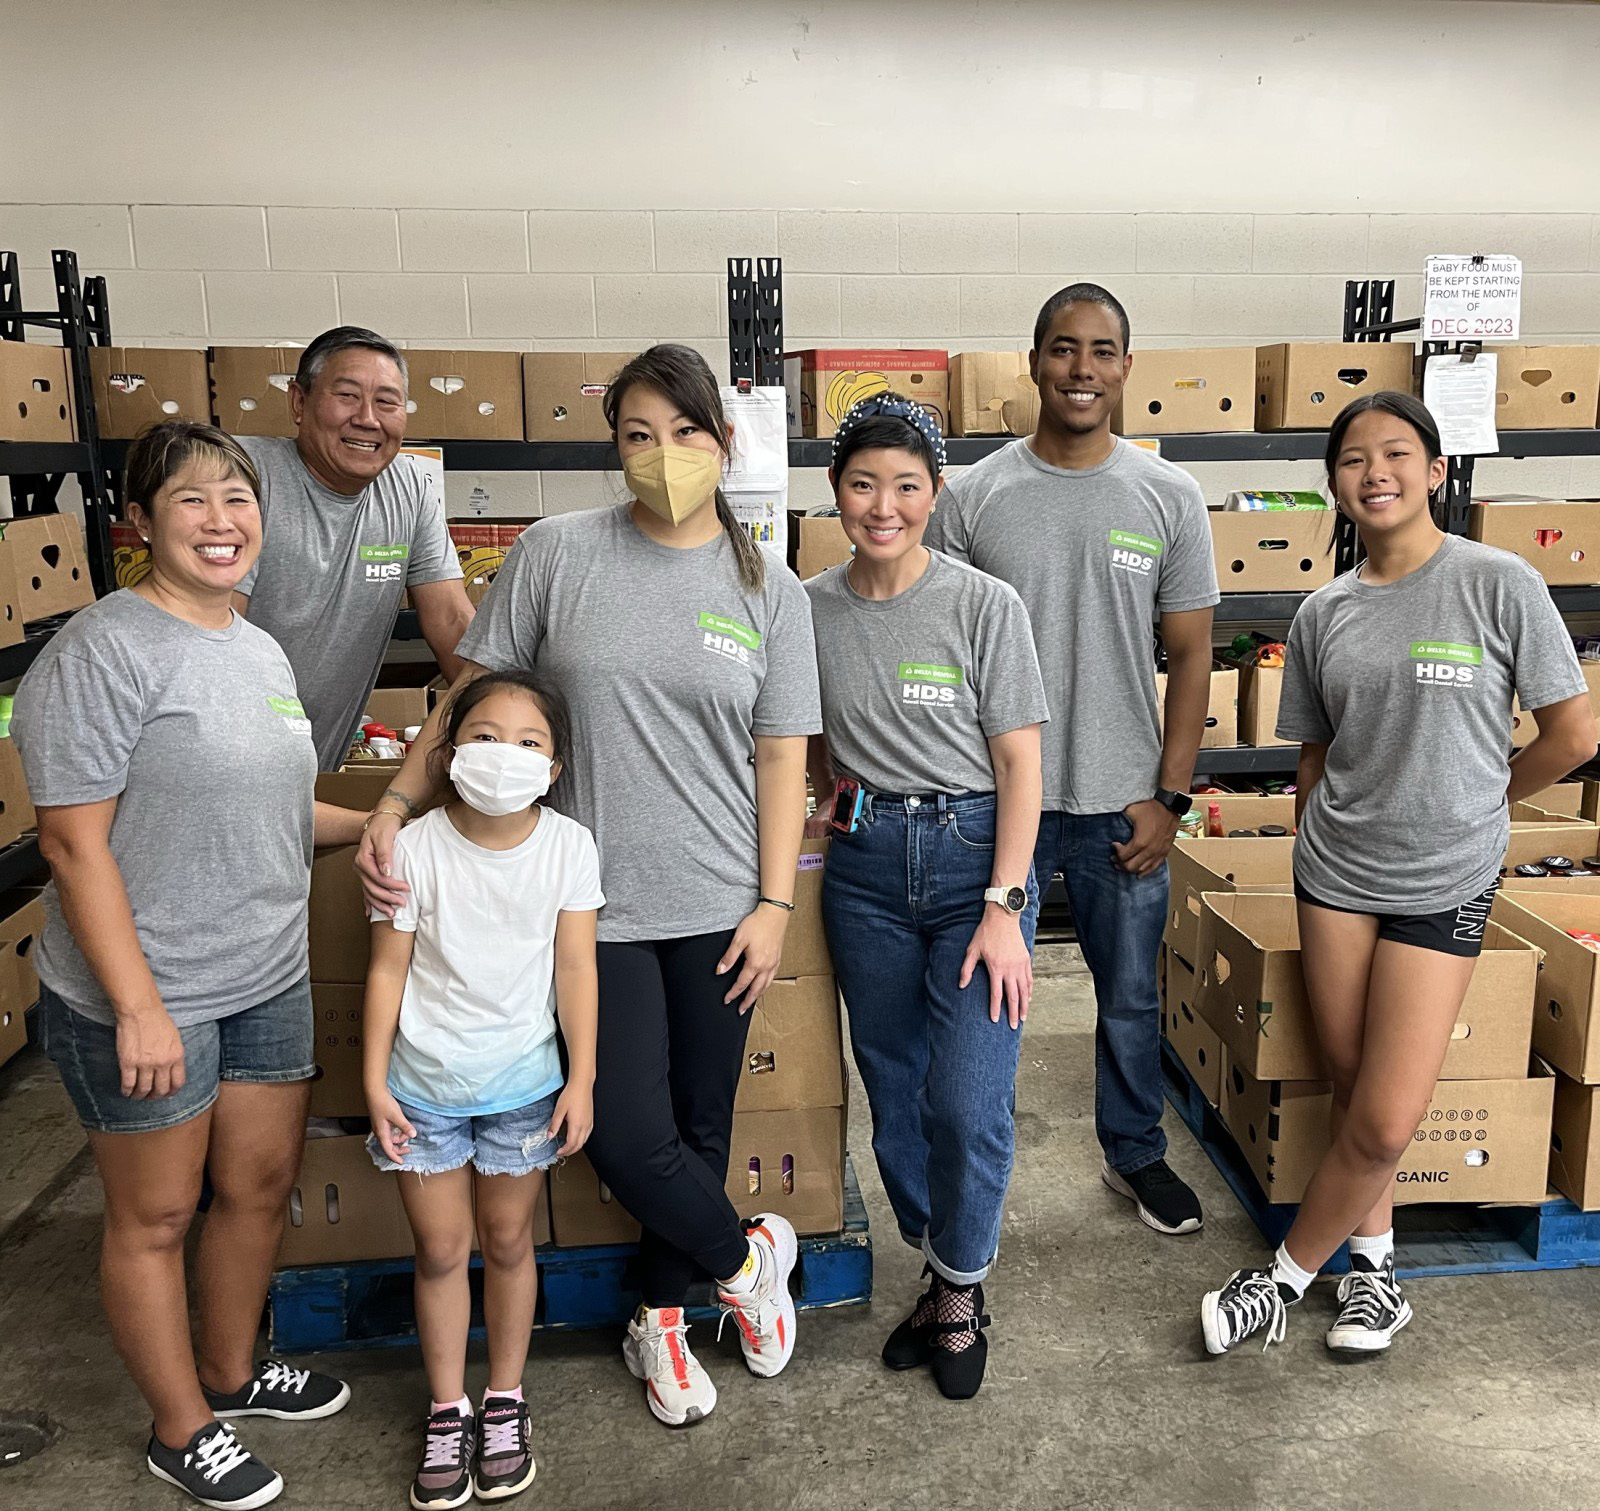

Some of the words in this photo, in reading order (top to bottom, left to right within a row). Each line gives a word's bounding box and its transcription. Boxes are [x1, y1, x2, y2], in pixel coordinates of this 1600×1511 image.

[1432, 264, 1459, 272] BABY
[1462, 264, 1489, 272] FOOD
[1492, 263, 1517, 272] MUST
[1429, 277, 1442, 286] BE
[1444, 276, 1470, 286] KEPT
[1473, 276, 1520, 285] STARTING
[1430, 290, 1458, 298] FROM
[1462, 290, 1480, 298] THE
[1483, 289, 1518, 298] MONTH
[1466, 302, 1480, 311] OF
[1432, 319, 1468, 334] DEC
[1474, 318, 1513, 334] 2023
[1112, 549, 1153, 570] HDS
[366, 563, 402, 577] HDS
[704, 632, 749, 662] HDS
[932, 670, 956, 678] DENTAL
[1416, 663, 1474, 682] HDS
[903, 684, 955, 702] HDS
[1396, 1171, 1449, 1183] GANIC
[485, 1408, 518, 1418] Skechers
[429, 1420, 462, 1428] Skechers
